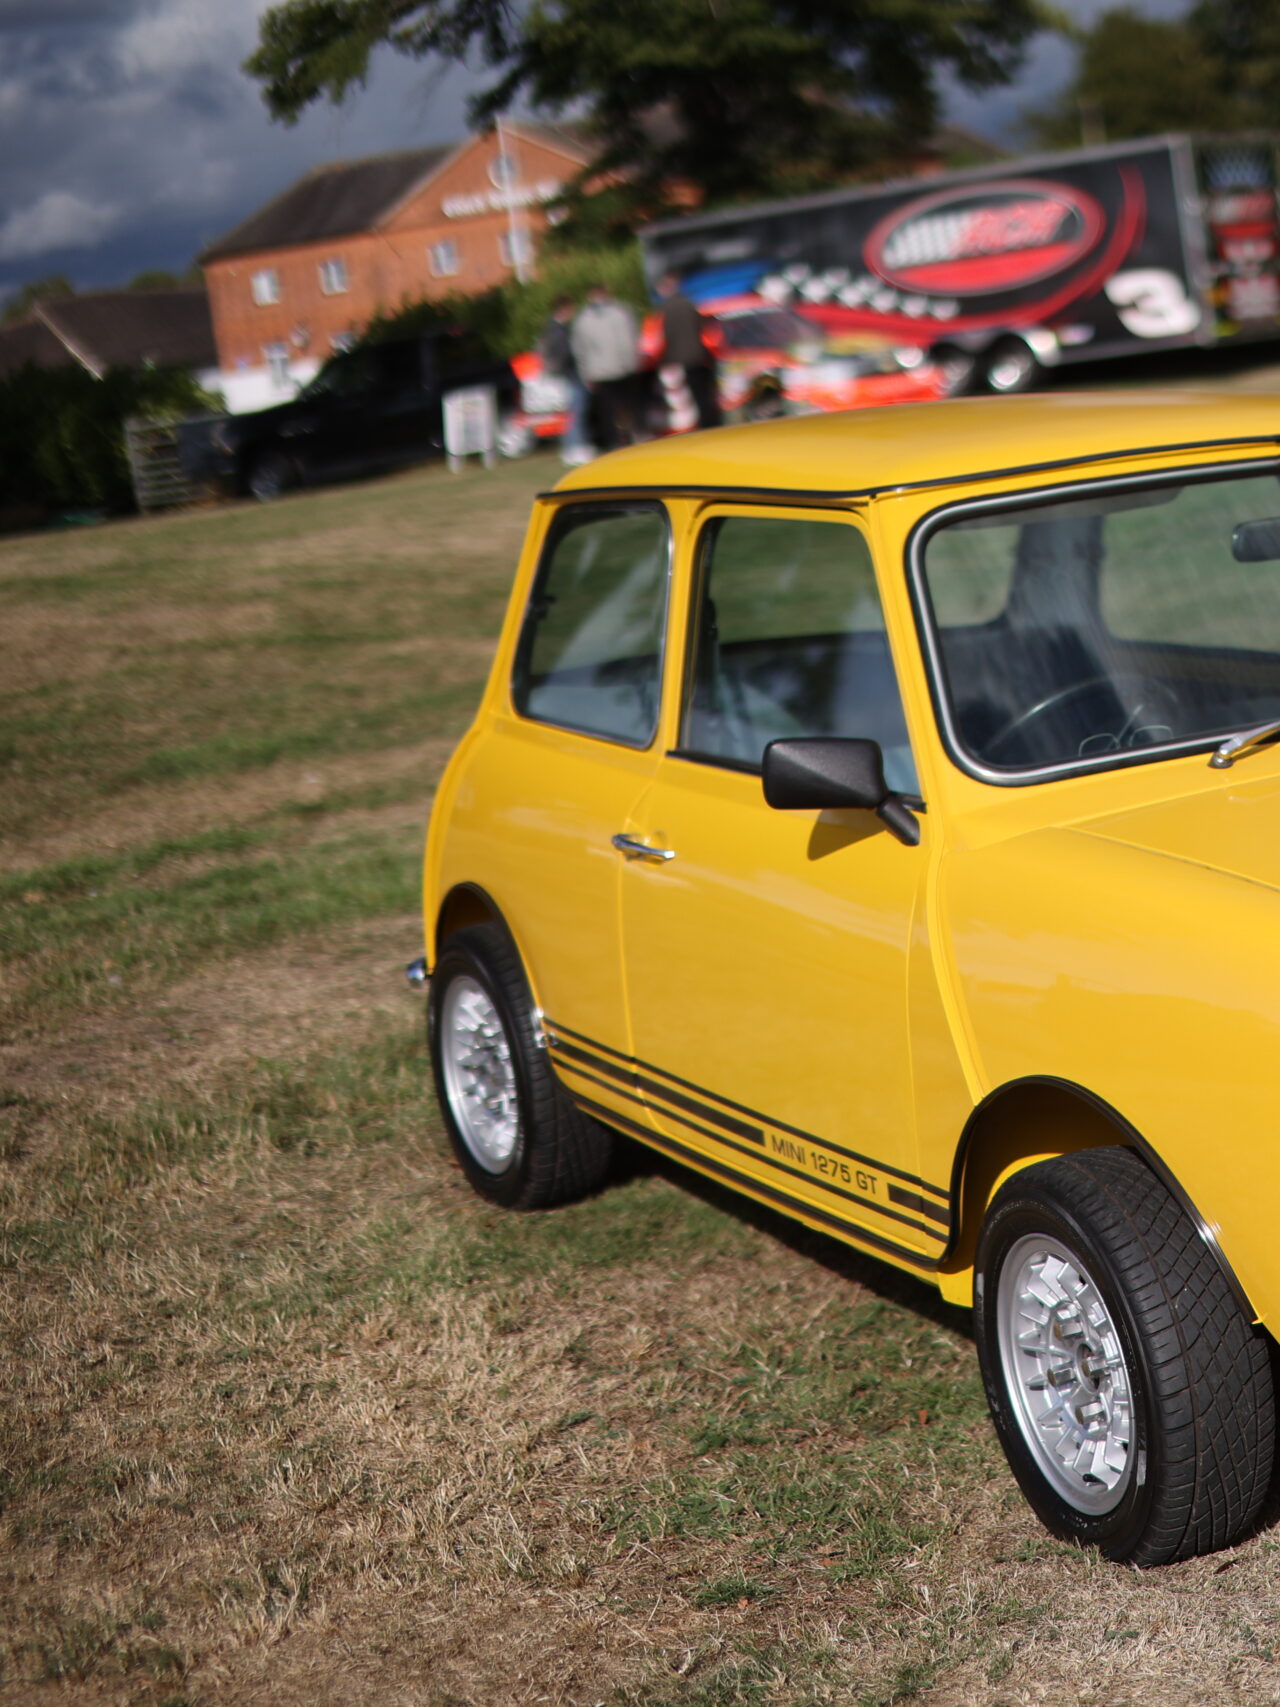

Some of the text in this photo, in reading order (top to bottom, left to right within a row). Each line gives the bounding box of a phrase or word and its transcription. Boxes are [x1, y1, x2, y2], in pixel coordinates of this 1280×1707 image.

[1104, 268, 1202, 338] 3
[771, 1134, 877, 1194] MINI 1275 GT
